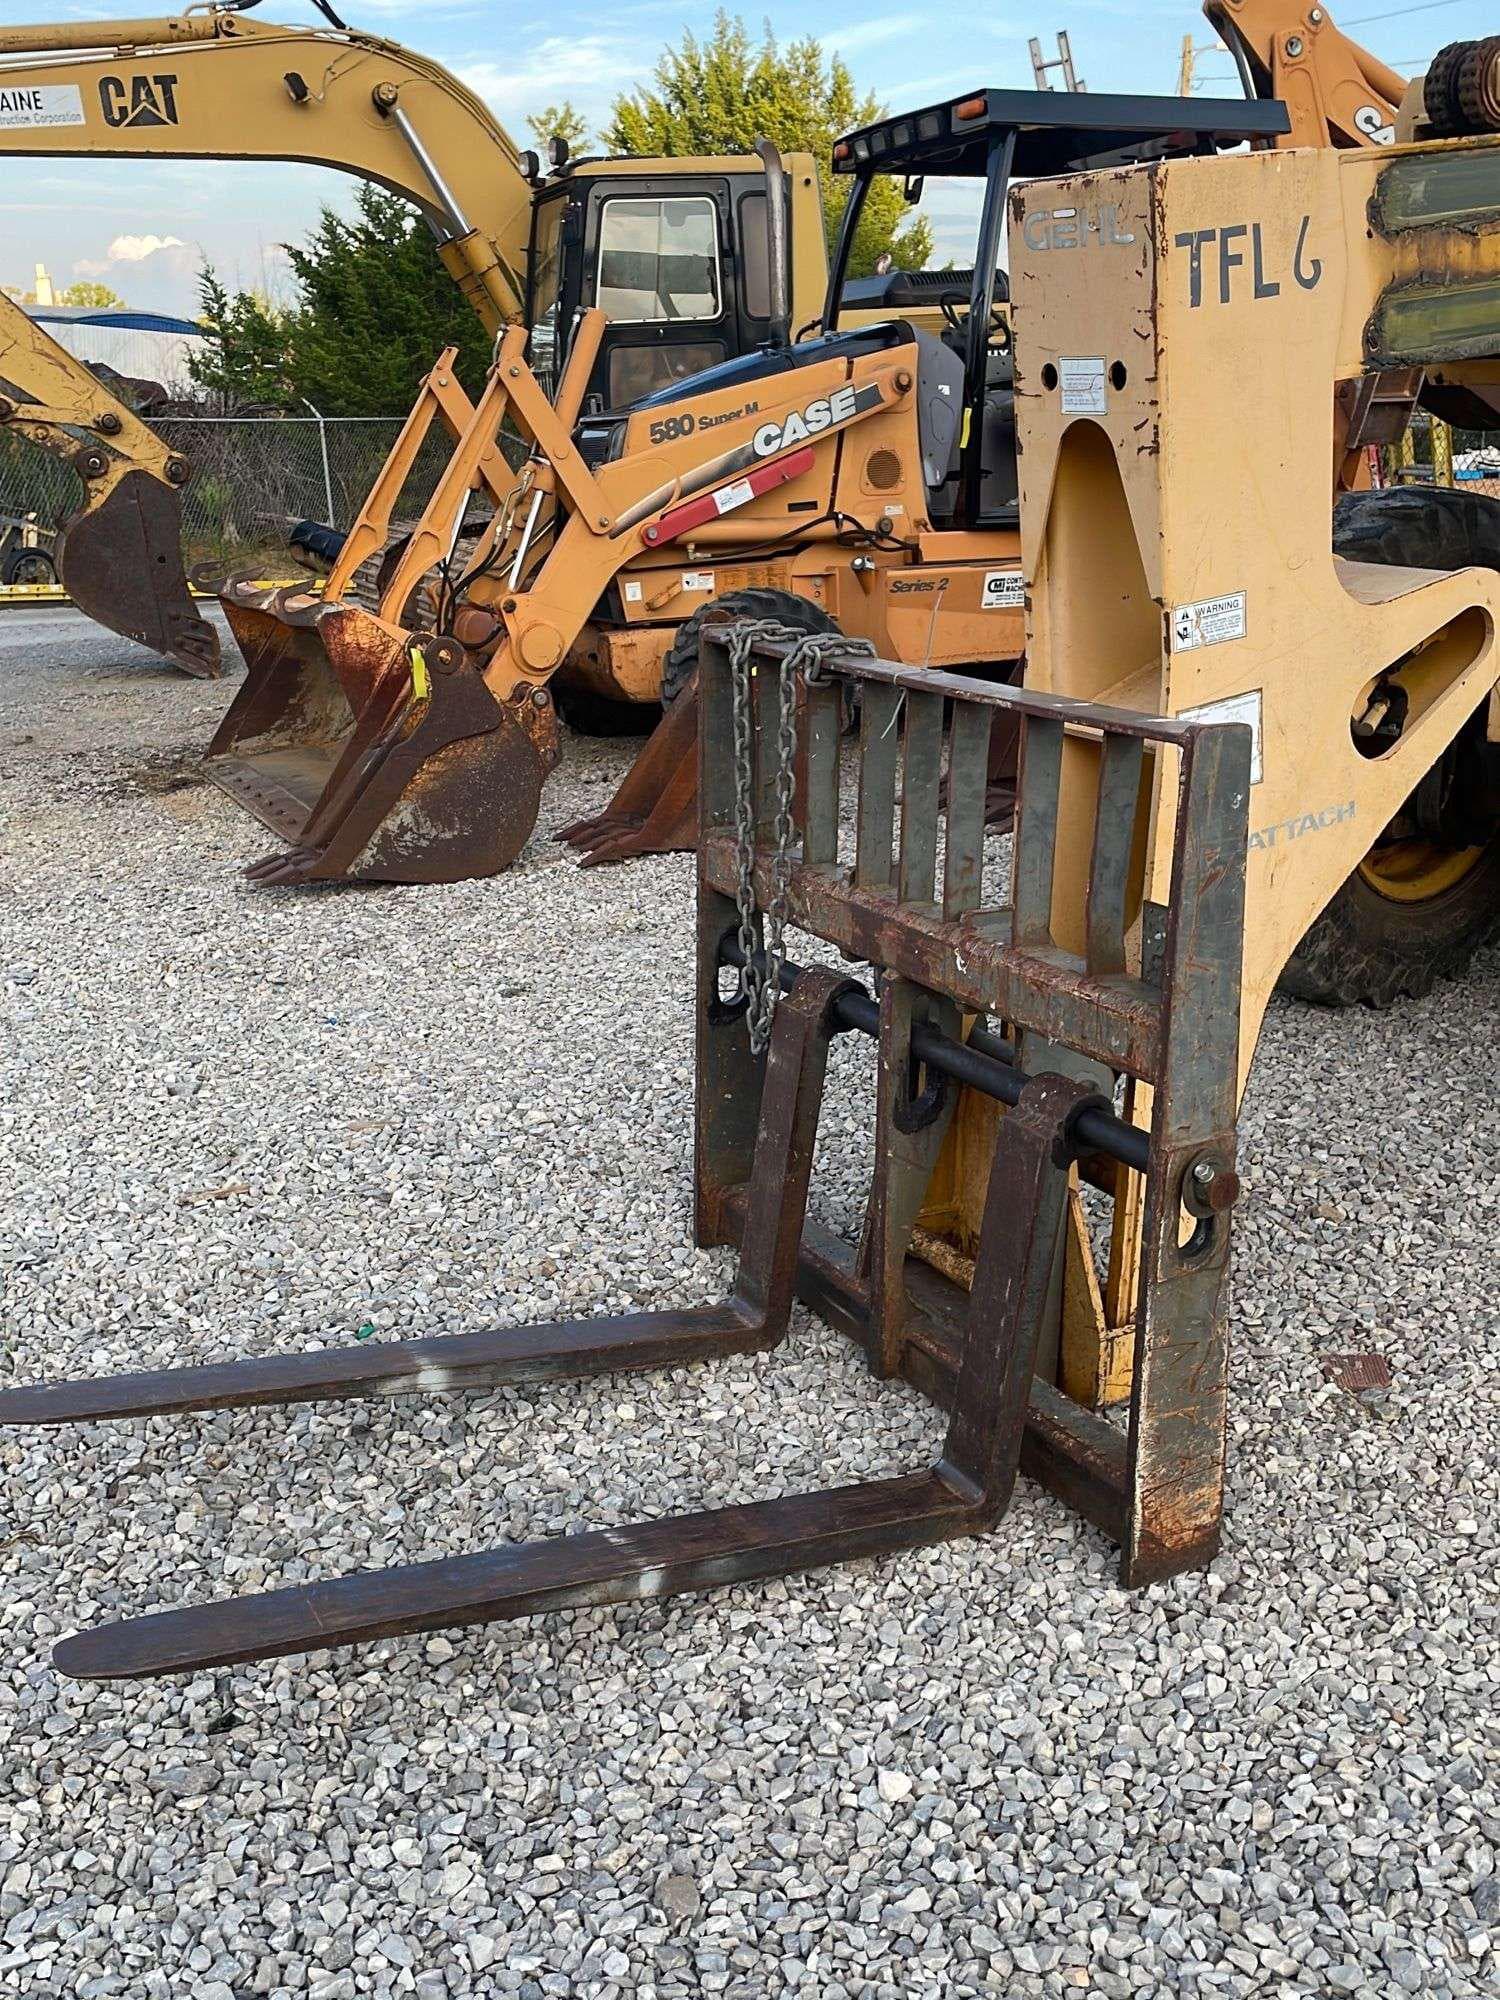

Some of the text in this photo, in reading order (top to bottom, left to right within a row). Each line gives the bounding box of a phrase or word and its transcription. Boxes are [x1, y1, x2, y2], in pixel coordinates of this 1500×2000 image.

[0, 91, 43, 111] AINE
[98, 74, 179, 128] CAT
[1024, 205, 1135, 250] GEHL
[1175, 215, 1322, 308] TFL 6
[650, 414, 695, 444] 580
[699, 409, 742, 430] Super
[752, 384, 857, 456] CASE
[890, 578, 950, 593] Series 2
[1194, 599, 1239, 615] WARNING
[1248, 800, 1357, 850] ATTACH
